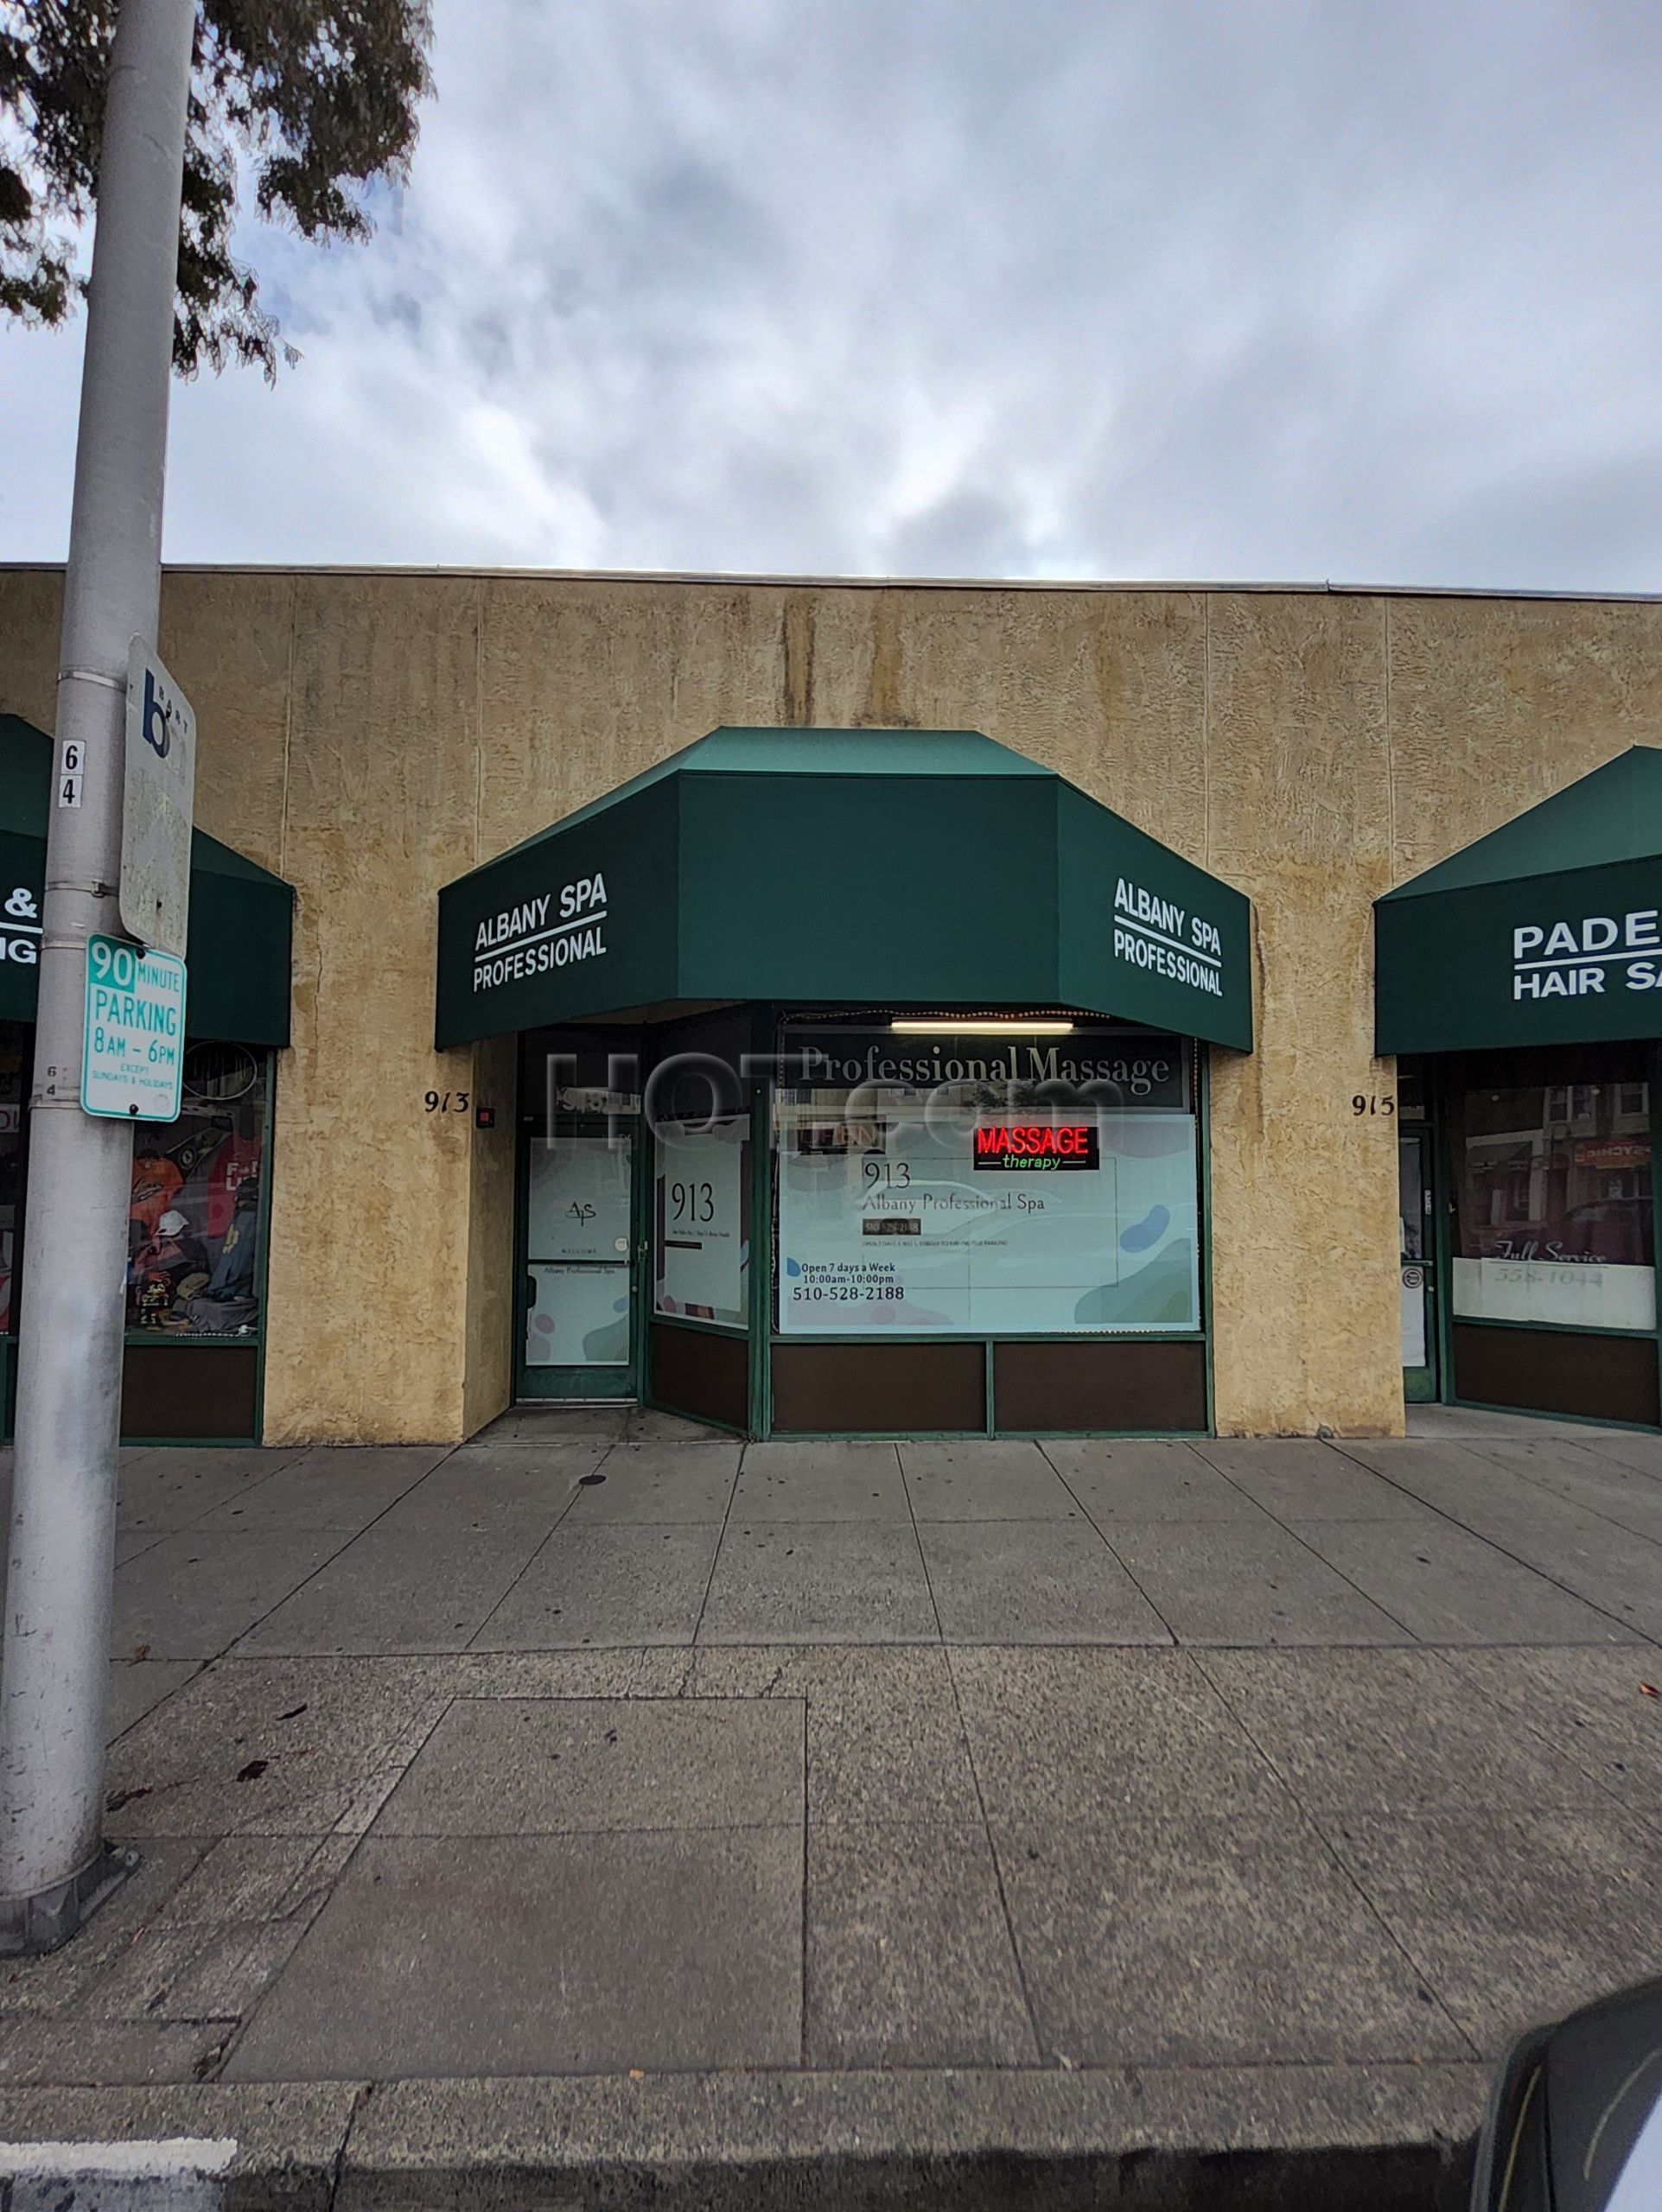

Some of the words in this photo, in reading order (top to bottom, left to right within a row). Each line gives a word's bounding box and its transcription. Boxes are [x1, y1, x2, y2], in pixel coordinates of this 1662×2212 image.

[4, 887, 38, 918] &
[474, 893, 551, 950] ALBANY
[559, 872, 608, 918] SPA
[1114, 877, 1186, 938] ALBANY
[1191, 917, 1222, 957] SPA
[1514, 910, 1660, 959] PADE
[91, 941, 133, 987] 90
[137, 961, 180, 993] MINUTE
[473, 926, 607, 993] PROFESSIONAL
[1113, 928, 1223, 997] PROFESSIONAL
[1514, 967, 1606, 1001] HAIR
[95, 988, 176, 1037] PARKING
[92, 1070, 128, 1084] SUNDAYS
[139, 1078, 174, 1090] HOLIDAYS
[120, 1063, 150, 1074] EXCEPT
[798, 1045, 1022, 1083] Professional
[1026, 1046, 1170, 1096] Massage
[424, 1090, 470, 1114] 913
[1352, 1094, 1395, 1116] 915
[977, 1127, 1089, 1154] MASSAGE
[864, 1162, 911, 1189] 913
[1002, 1154, 1062, 1172] therapy
[672, 1182, 714, 1223] 913
[863, 1193, 917, 1214] Albany
[922, 1192, 1012, 1211] Professional
[1017, 1193, 1046, 1213] Spa
[1495, 1240, 1539, 1262] Full
[1539, 1241, 1607, 1263] Service
[801, 1262, 827, 1274] Open
[829, 1262, 835, 1272] 7
[837, 1262, 859, 1274] days
[869, 1262, 896, 1272] Week
[804, 1274, 895, 1285] 10:00am-10:00pm
[793, 1287, 905, 1300] 510-528-2188
